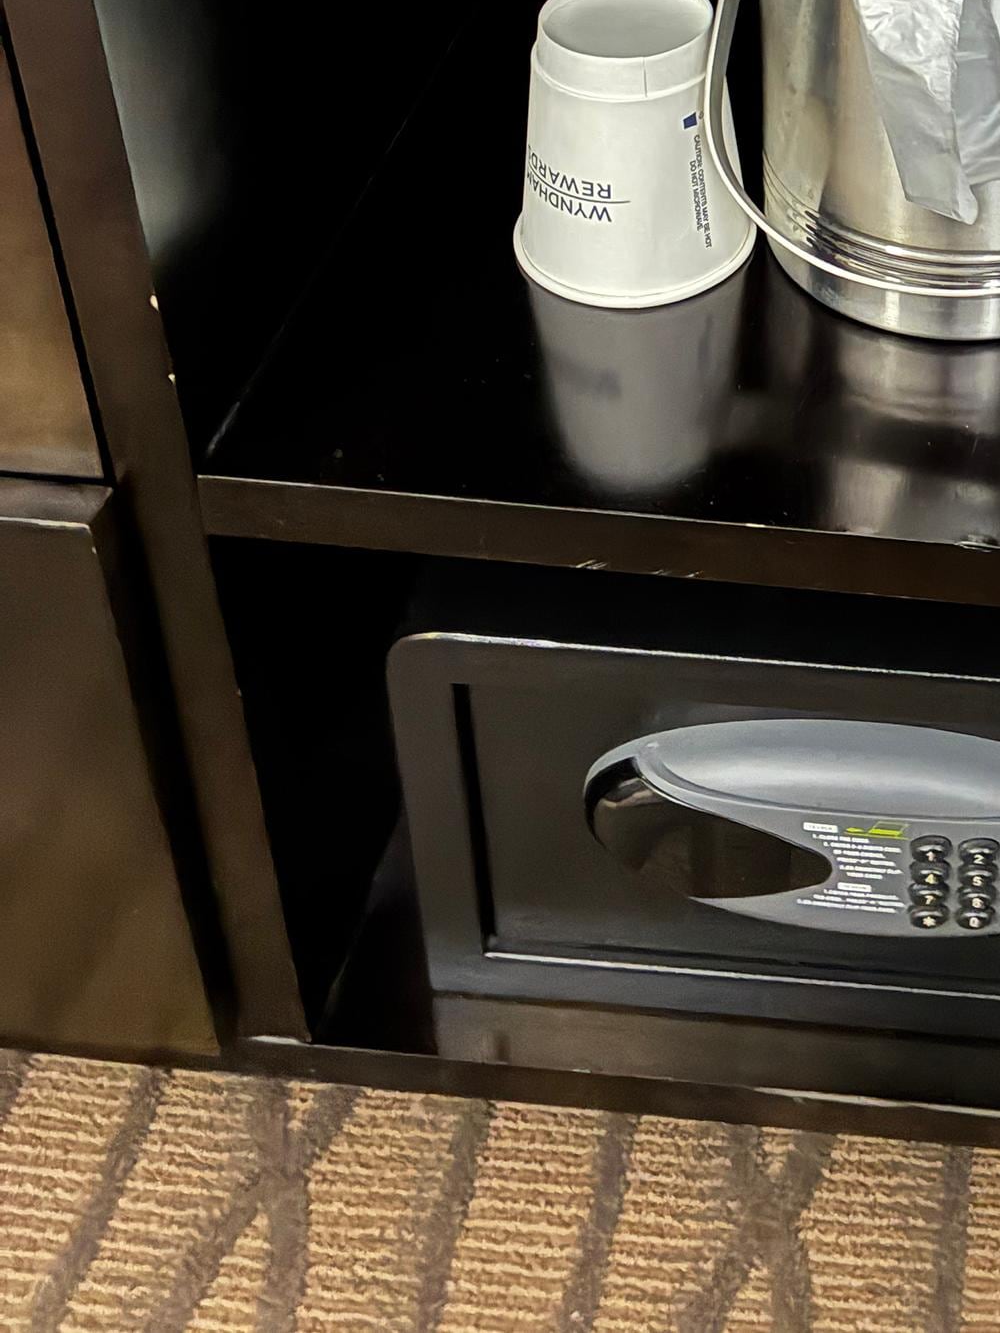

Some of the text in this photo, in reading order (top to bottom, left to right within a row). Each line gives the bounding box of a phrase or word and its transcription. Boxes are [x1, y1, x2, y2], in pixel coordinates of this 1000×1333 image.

[689, 160, 697, 171] DO
[698, 169, 707, 206] CONTENTS
[704, 233, 712, 248] HOT
